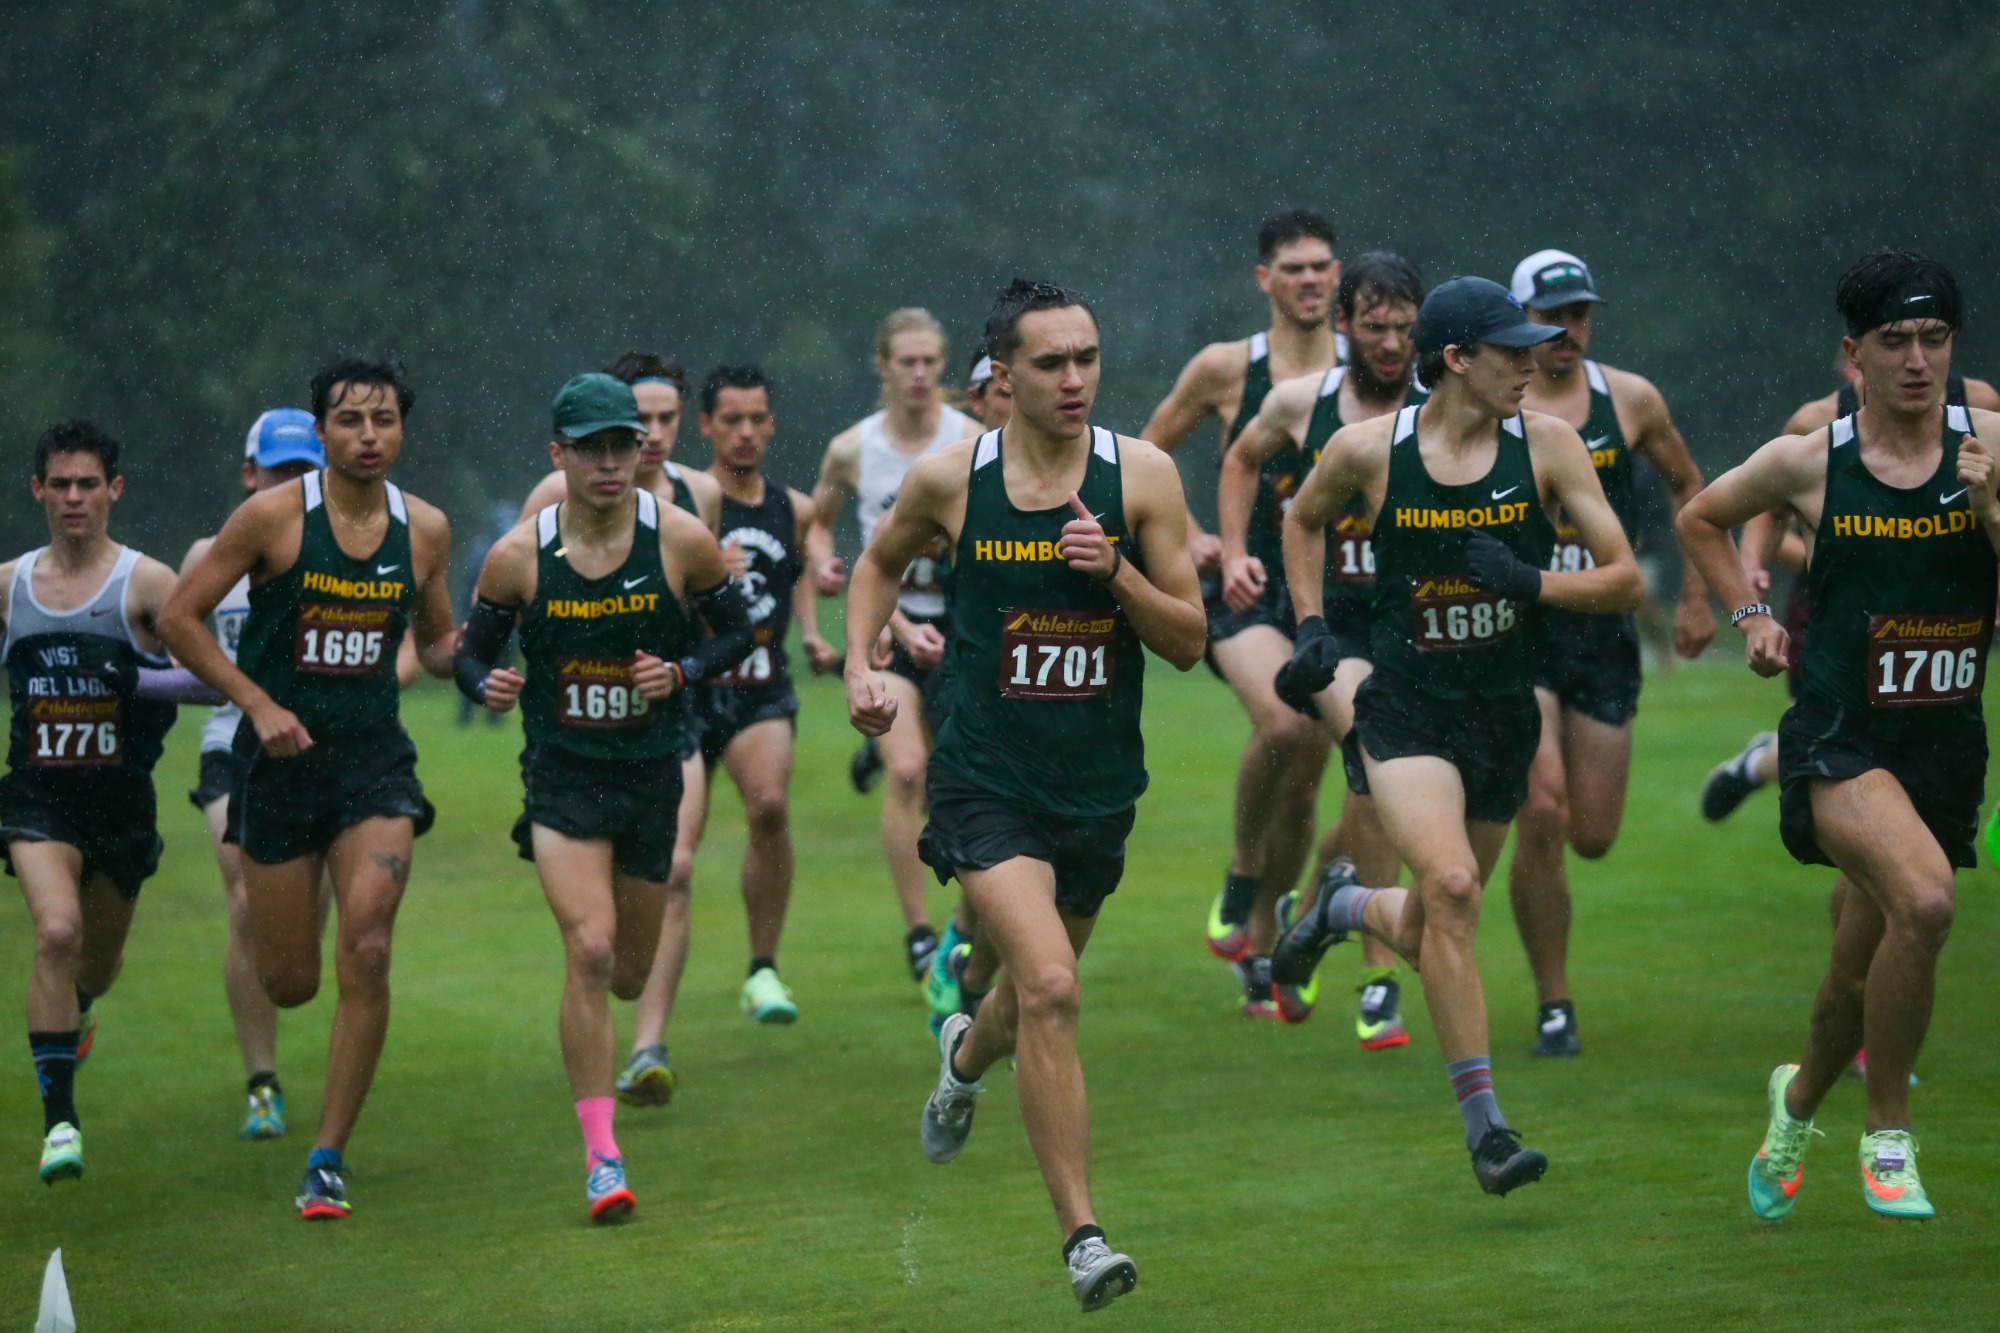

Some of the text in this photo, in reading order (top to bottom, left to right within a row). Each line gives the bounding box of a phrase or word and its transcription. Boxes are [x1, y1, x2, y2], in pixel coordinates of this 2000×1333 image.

[1395, 502, 1529, 528] HUMBOLDT
[1833, 509, 1976, 538] HUMBOLDT
[303, 570, 404, 600] HUMBOLDT
[547, 593, 659, 619] HUMBOLDT
[302, 628, 384, 666] 1695
[1010, 643, 1108, 688] 1701
[1878, 647, 1977, 694] 1706
[36, 721, 117, 758] 1776
